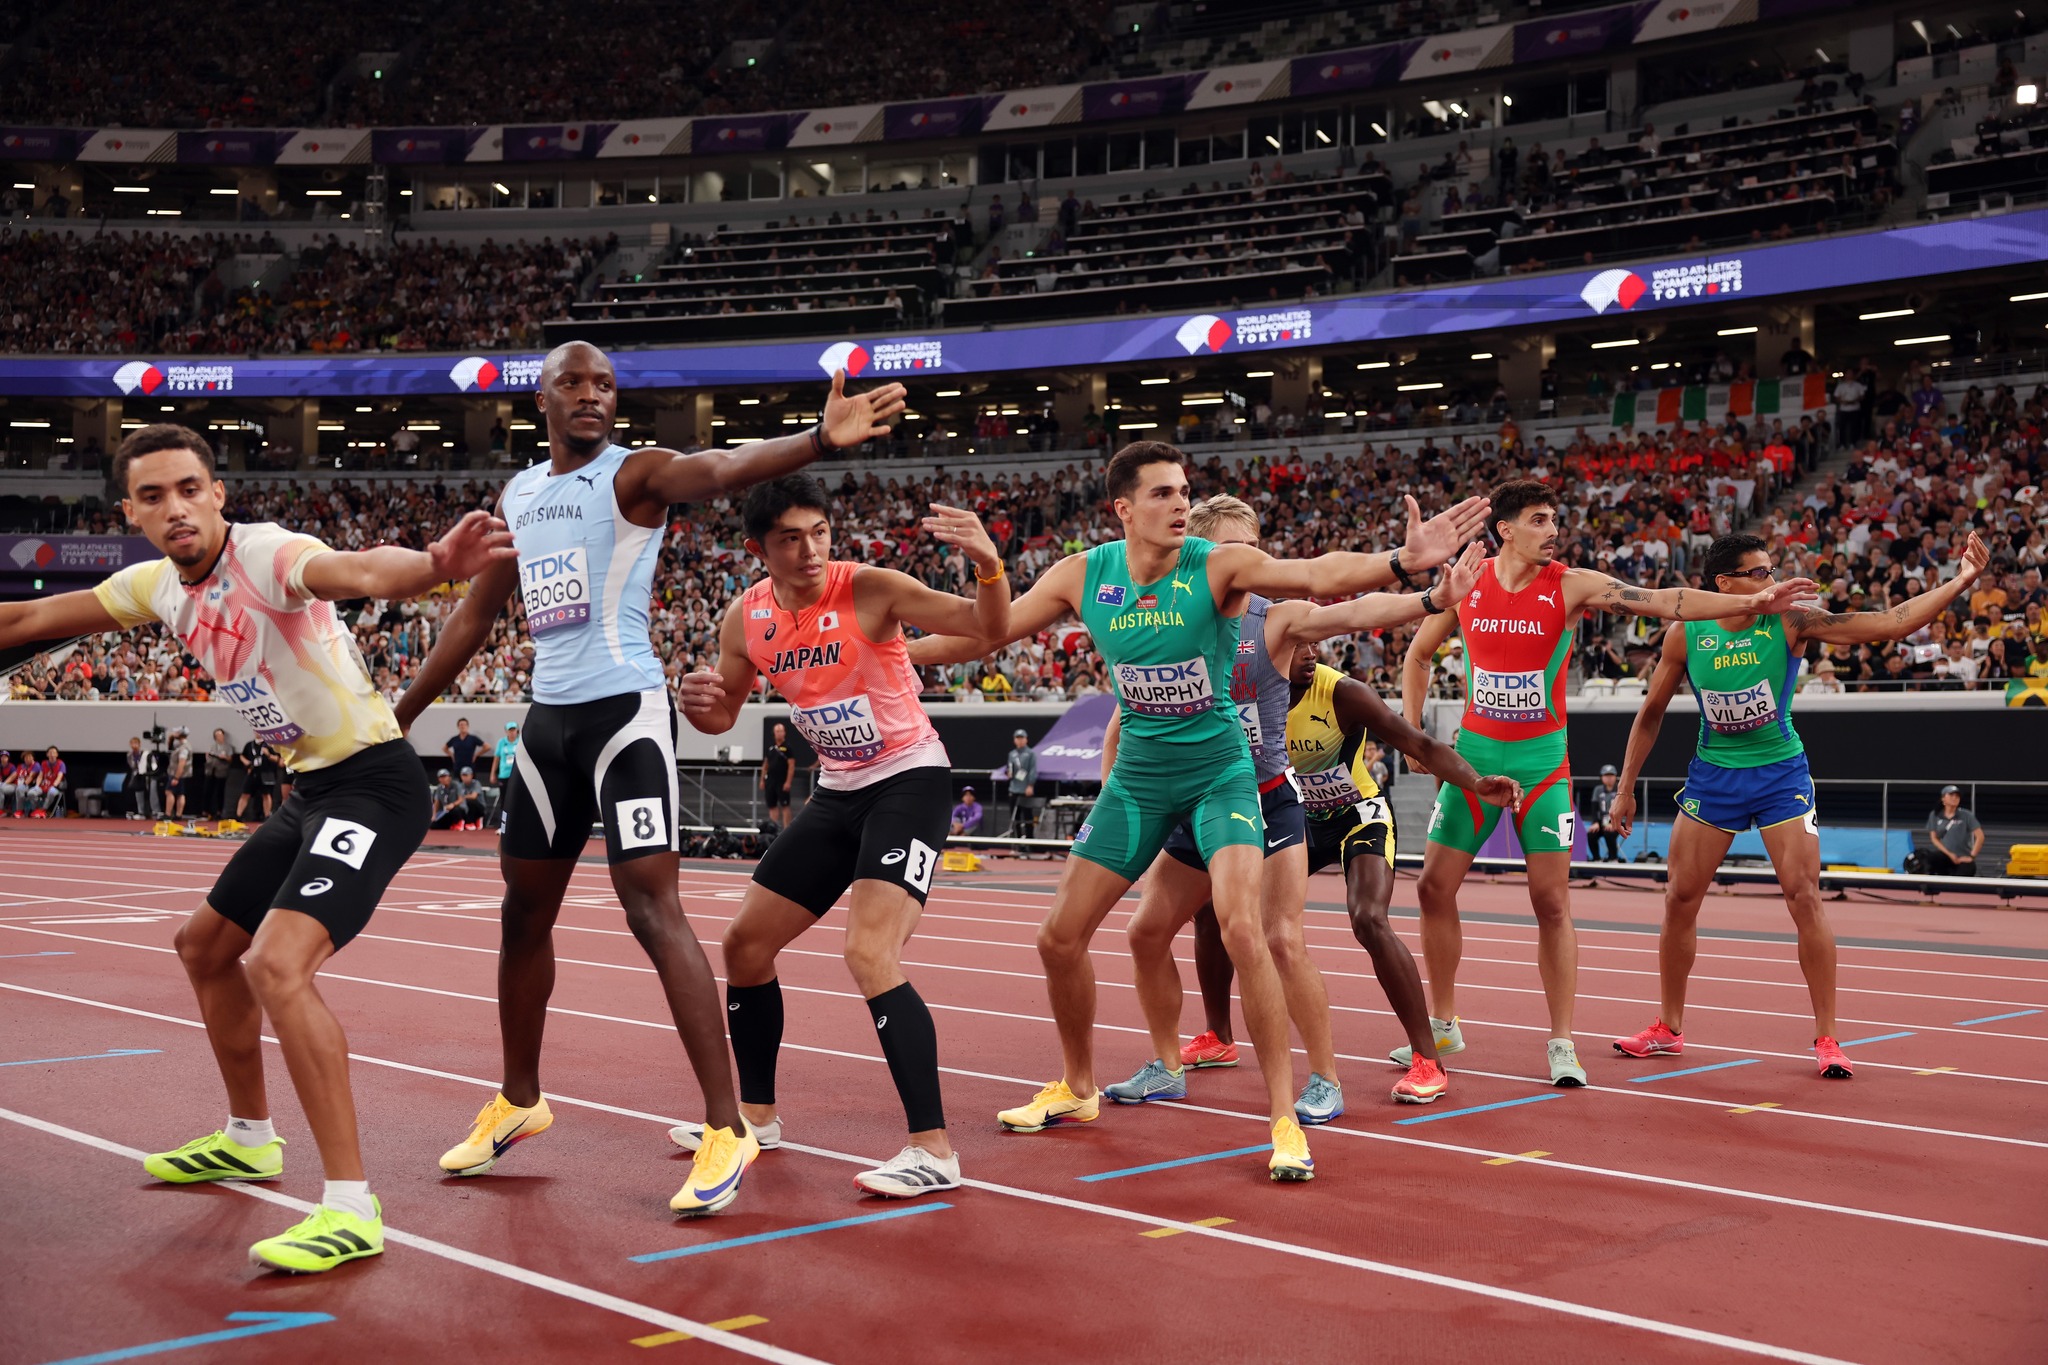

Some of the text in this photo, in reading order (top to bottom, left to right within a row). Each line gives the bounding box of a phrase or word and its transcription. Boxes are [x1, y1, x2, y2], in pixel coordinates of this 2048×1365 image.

[1652, 259, 1743, 280] WORLD ATHLETICS
[1652, 269, 1743, 290] CHAMPIONSHIPS
[1236, 310, 1312, 326] WORLD ATHLETICS
[1236, 319, 1312, 335] CHAMPIONSHIPS
[873, 341, 942, 353] WORLD ATHLETICS
[873, 350, 942, 361] CHAMPIONSHIPS
[515, 504, 584, 530] BOTSWANA
[526, 551, 578, 583] TDK
[1109, 611, 1185, 632] AUSTRALIA
[1470, 618, 1545, 636] PORTUGAL
[769, 640, 841, 675] JAPAN
[1714, 652, 1761, 671] BRASIL
[1136, 661, 1200, 683] TDK
[1489, 673, 1539, 690] TDK
[220, 676, 268, 705] TDK
[1122, 678, 1205, 703] MURPHY
[1476, 688, 1541, 708] COELHO
[1718, 683, 1767, 706] TDK
[237, 702, 284, 729] GERS
[801, 698, 865, 727] TDK
[1711, 700, 1769, 722] VILAR
[1290, 739, 1325, 753] AICA
[1297, 767, 1345, 787] TDK
[1300, 782, 1353, 801] ENNIS
[1366, 800, 1383, 820] 2
[632, 806, 656, 840] 8
[1566, 818, 1574, 842] 7
[330, 829, 359, 855] 6
[914, 850, 927, 882] 3
